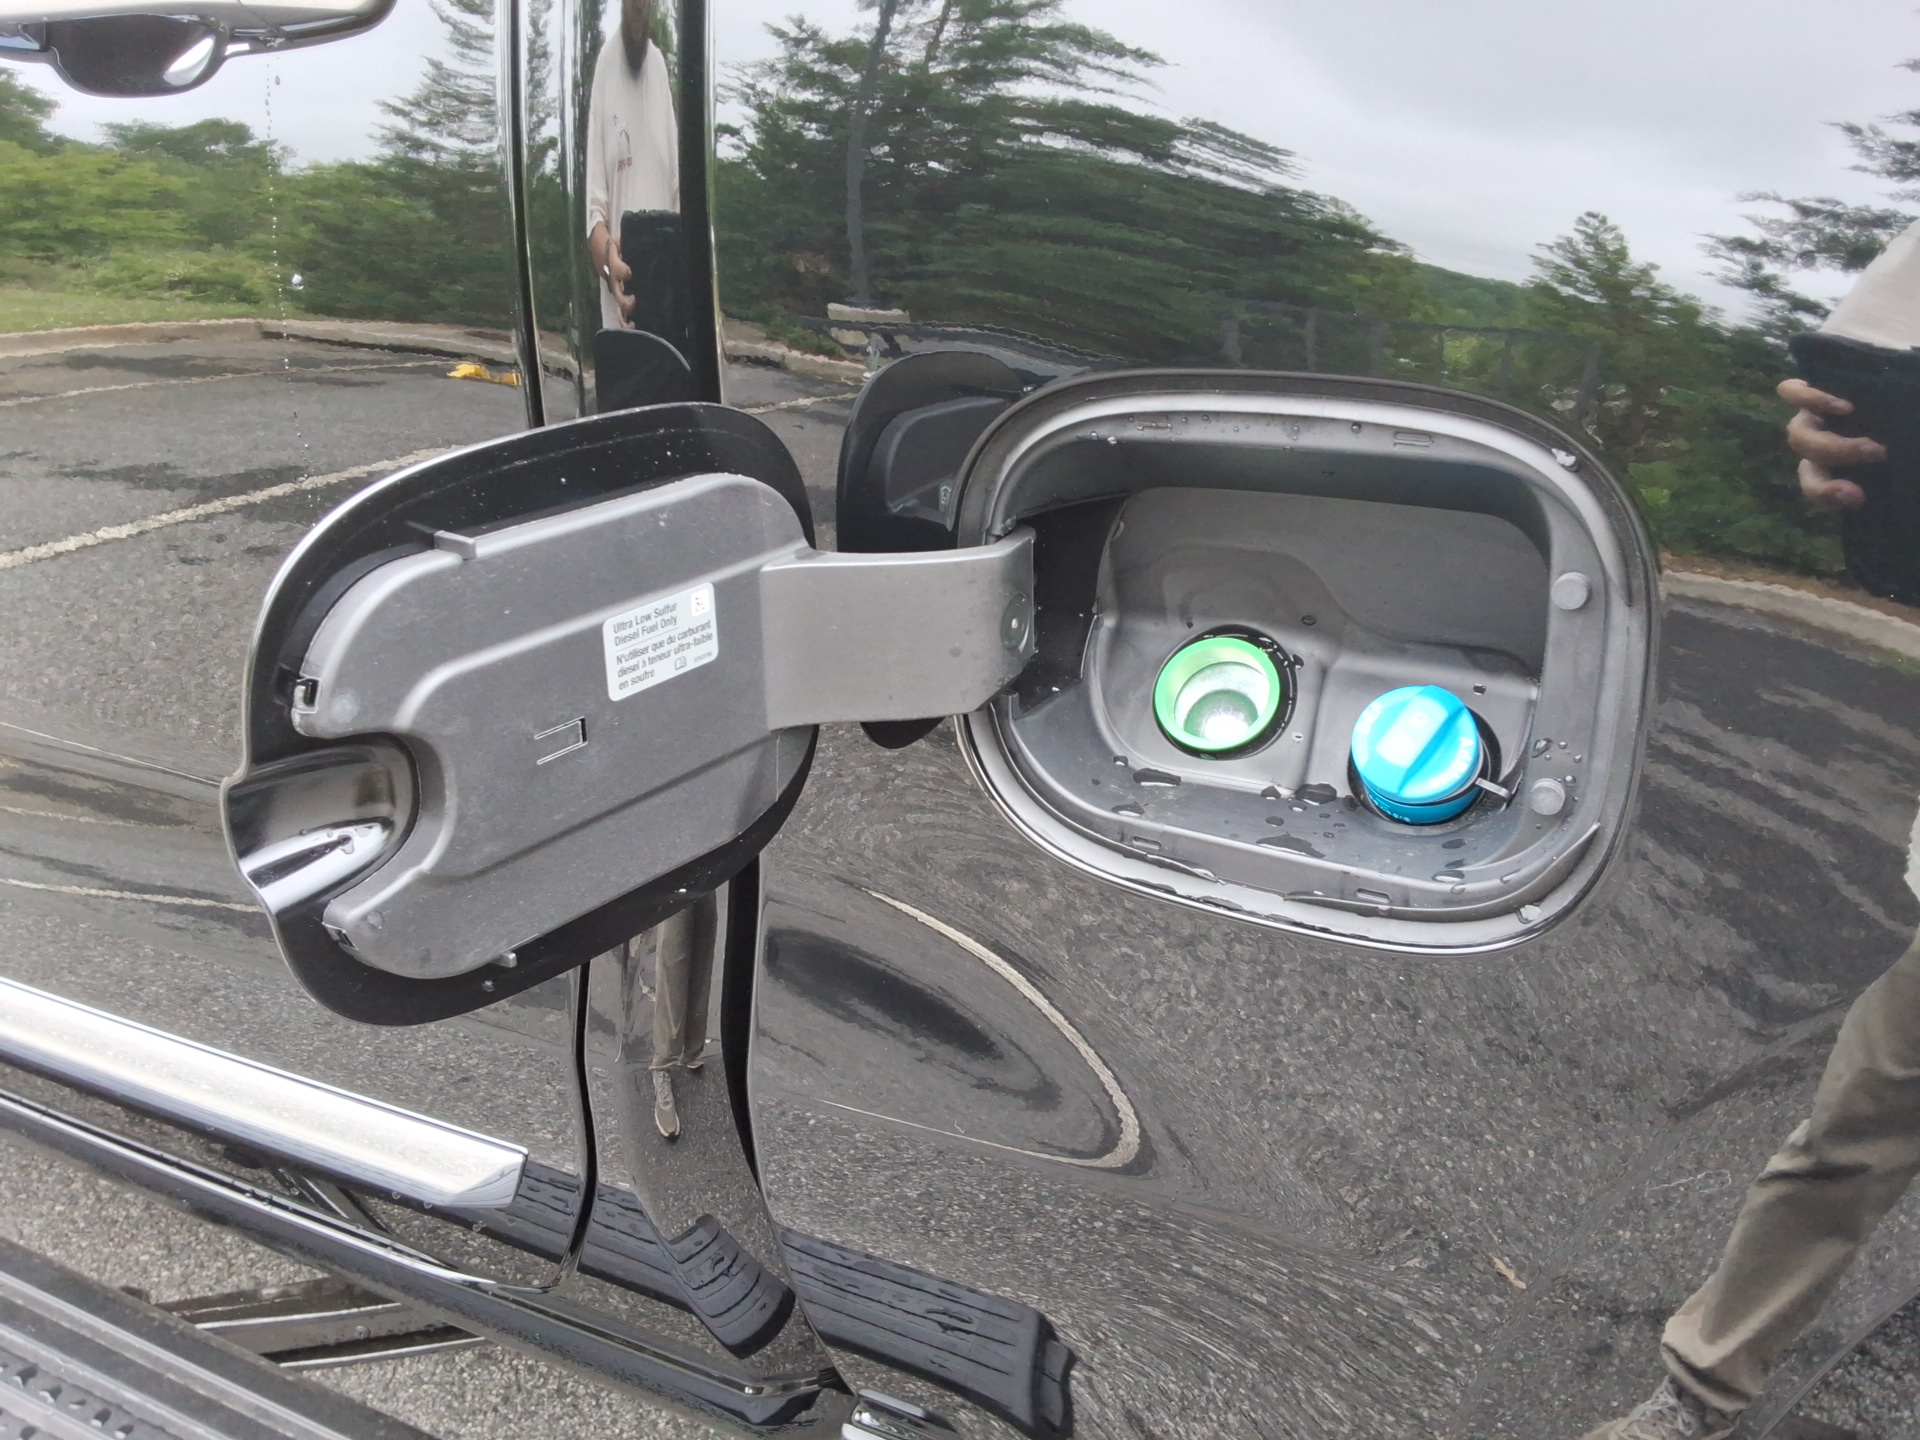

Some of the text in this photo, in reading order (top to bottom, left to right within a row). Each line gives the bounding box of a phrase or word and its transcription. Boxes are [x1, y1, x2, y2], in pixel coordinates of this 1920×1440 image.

[614, 603, 677, 633] Ultra Low Sulfur
[615, 616, 678, 646] Diesel Fuel Only
[617, 621, 711, 665] N'utiliser que du carburant
[618, 633, 713, 677] diesel à teneur ultra-faible
[619, 670, 655, 690] en soufre
[1356, 702, 1383, 734] DEF
